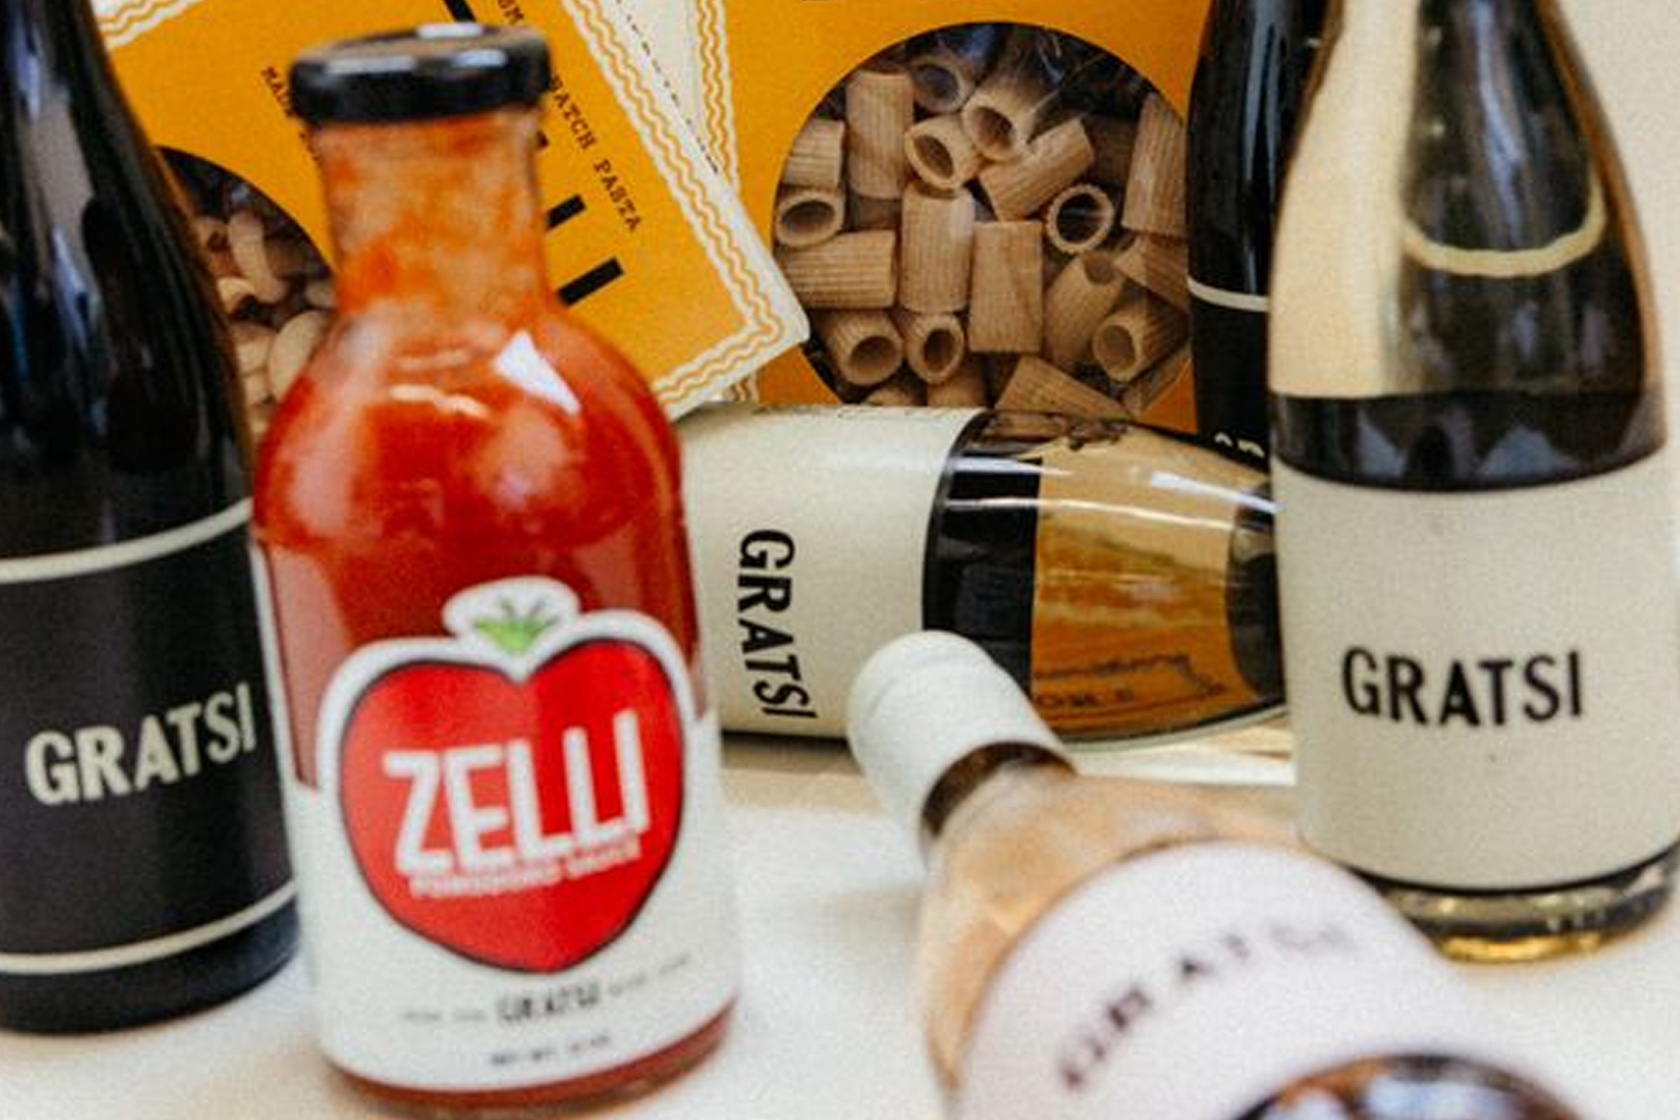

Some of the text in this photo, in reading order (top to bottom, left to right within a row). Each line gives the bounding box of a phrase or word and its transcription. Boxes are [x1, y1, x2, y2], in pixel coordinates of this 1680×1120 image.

[593, 158, 643, 232] PASTA
[737, 529, 819, 719] GRATSI
[1342, 646, 1582, 727] GRATSI
[24, 682, 257, 807] GRATSI
[382, 708, 651, 878] ZELLI
